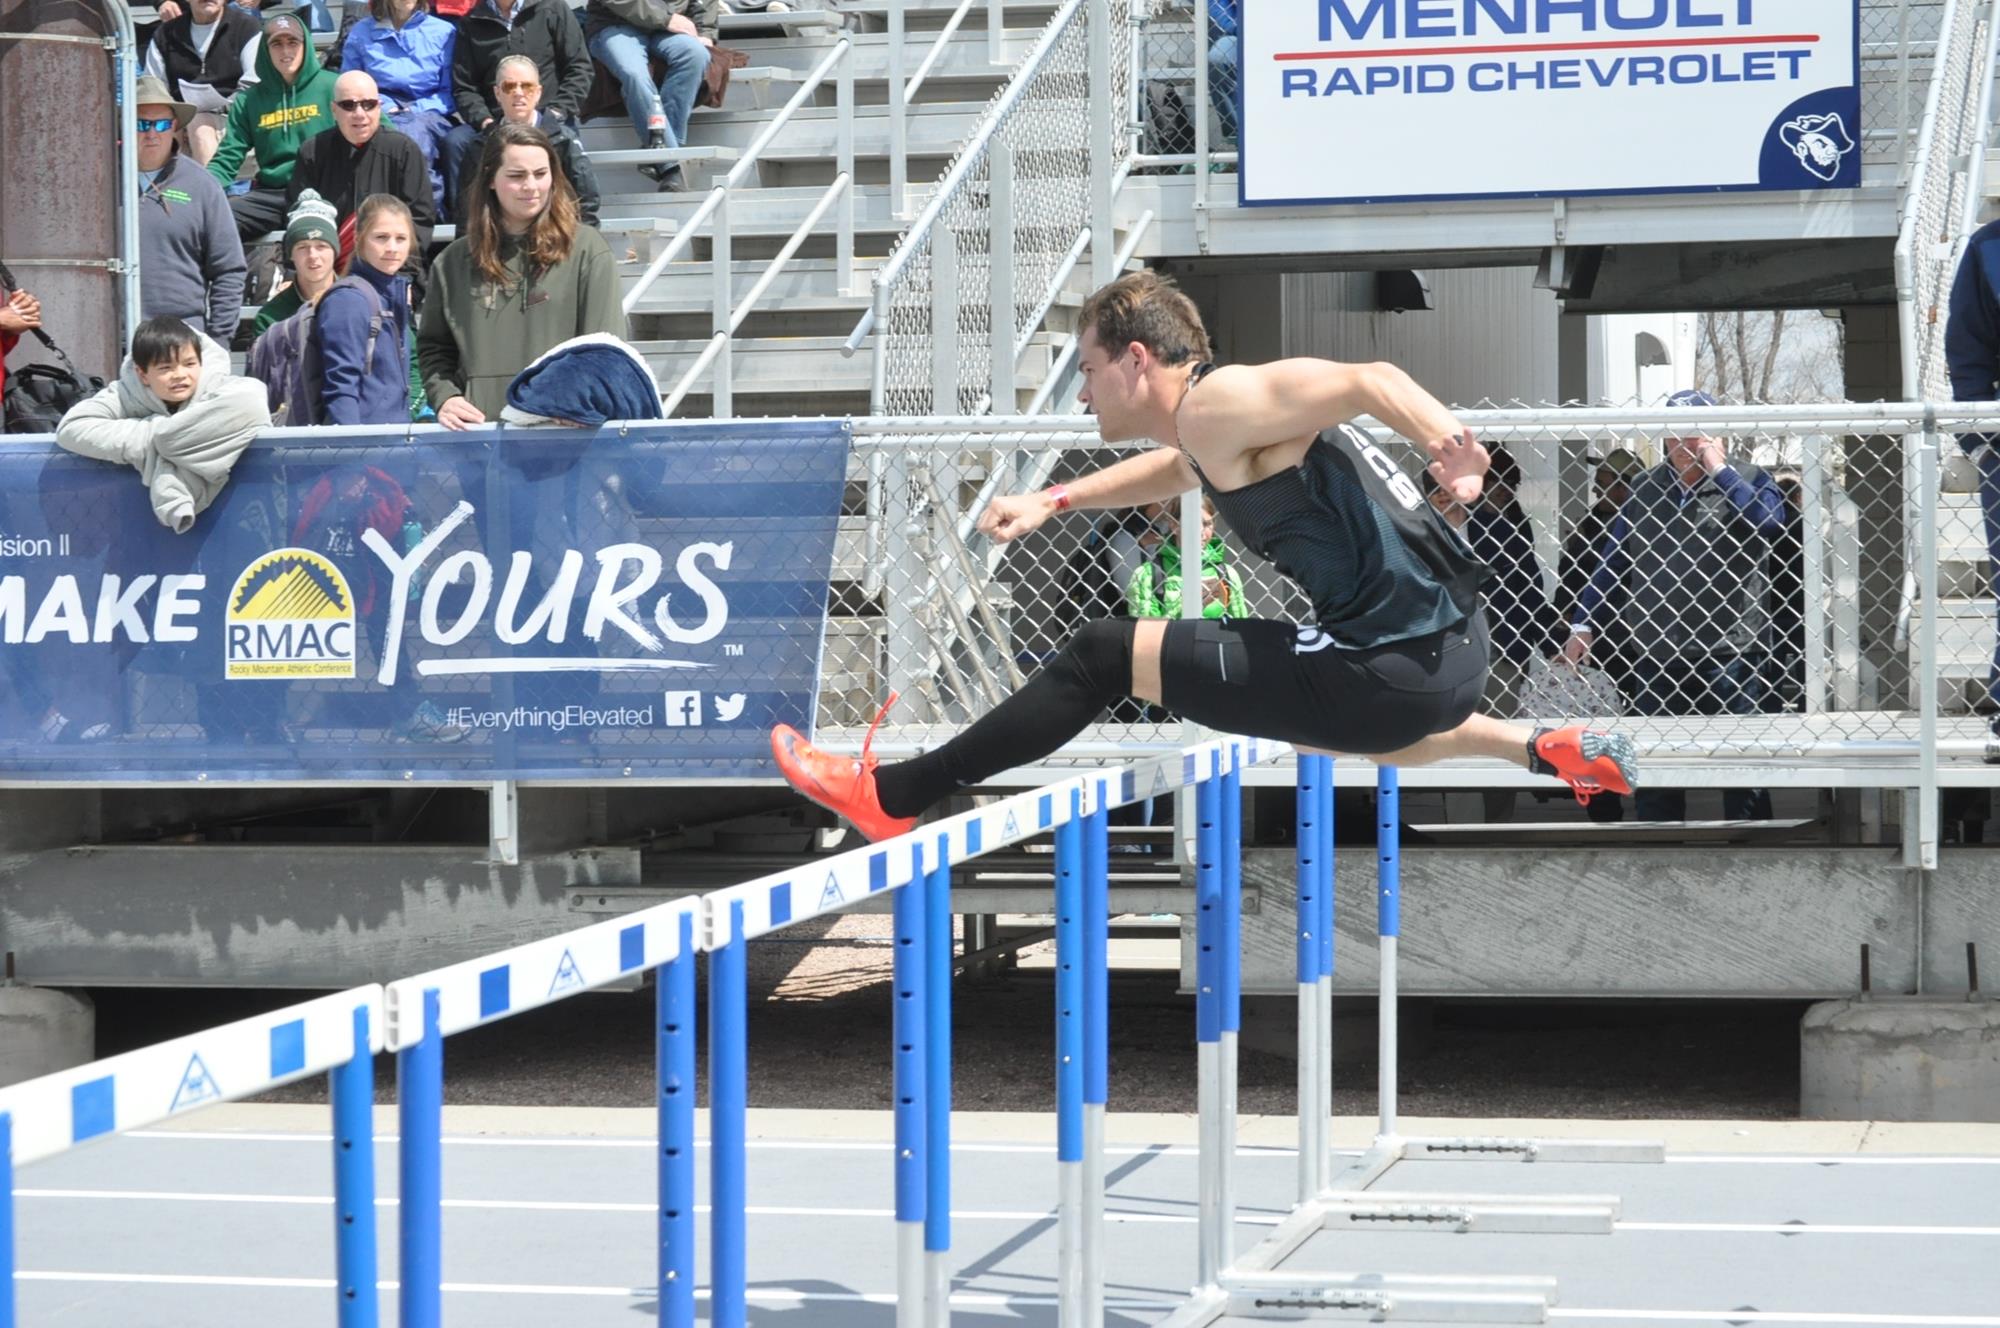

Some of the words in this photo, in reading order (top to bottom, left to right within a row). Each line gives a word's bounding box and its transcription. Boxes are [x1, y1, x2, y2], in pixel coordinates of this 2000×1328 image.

[1282, 64, 1455, 98] RAPID
[1468, 50, 1811, 92] CHEVROLET
[0, 573, 206, 644] MAKE
[361, 500, 734, 687] YOURS
[228, 622, 352, 659] RMAC
[446, 705, 653, 731] #EverythingElevated
